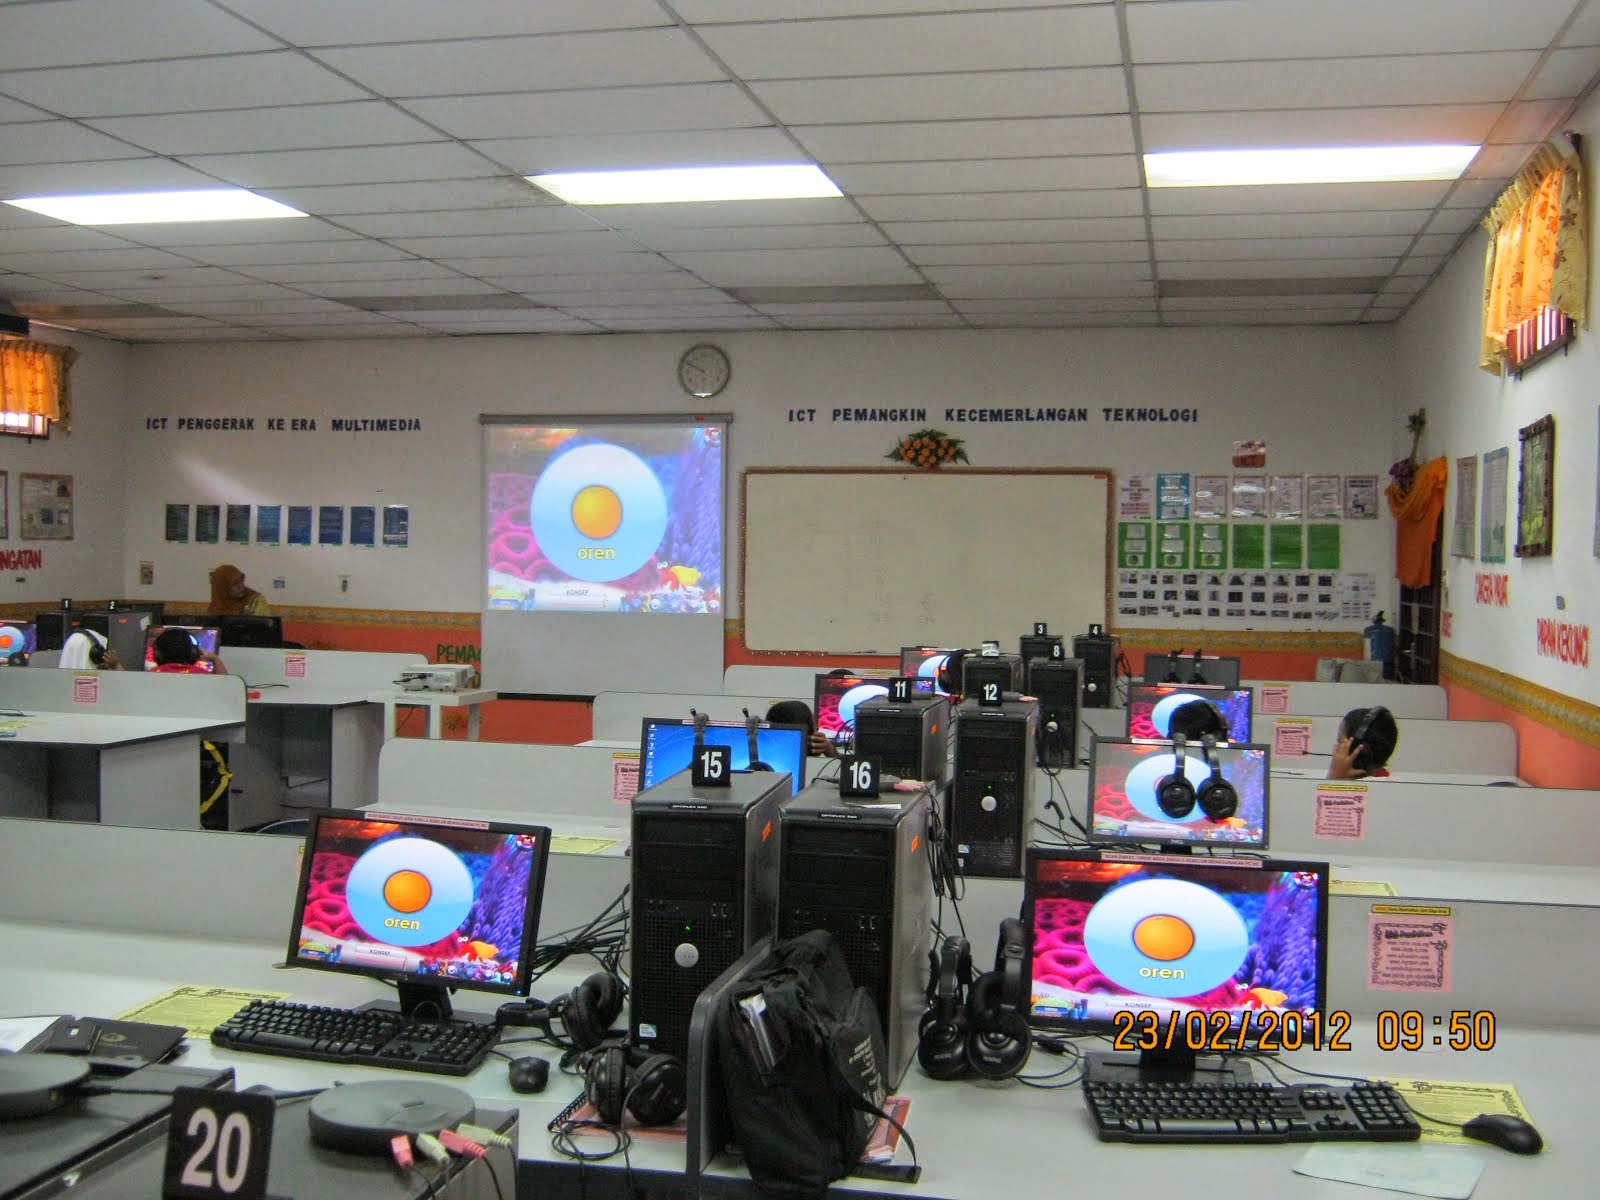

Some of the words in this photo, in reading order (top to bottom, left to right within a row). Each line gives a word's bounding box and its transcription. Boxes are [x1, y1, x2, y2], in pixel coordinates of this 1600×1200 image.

[788, 408, 816, 422] ICT
[832, 408, 926, 422] PEMANGKIN
[945, 408, 1088, 422] KECEMERLANGAN
[1103, 408, 1198, 422] TEKNOLOGI
[146, 417, 168, 430] ICT
[178, 418, 254, 430] PENGGERAK
[267, 418, 285, 431] KE
[291, 418, 317, 431] ERA
[332, 418, 421, 432] MULTIMEDIA
[577, 547, 616, 560] oren
[64, 600, 69, 608] 1
[109, 601, 115, 610] 2
[1037, 624, 1044, 634] 3
[1092, 625, 1098, 636] 4
[1053, 644, 1060, 658] 8
[894, 680, 906, 698] 11
[983, 683, 998, 701] 12
[701, 751, 722, 778] 15
[849, 761, 871, 790] 16
[383, 916, 421, 931] oren
[1138, 965, 1186, 980] oren
[181, 1106, 252, 1193] 20
